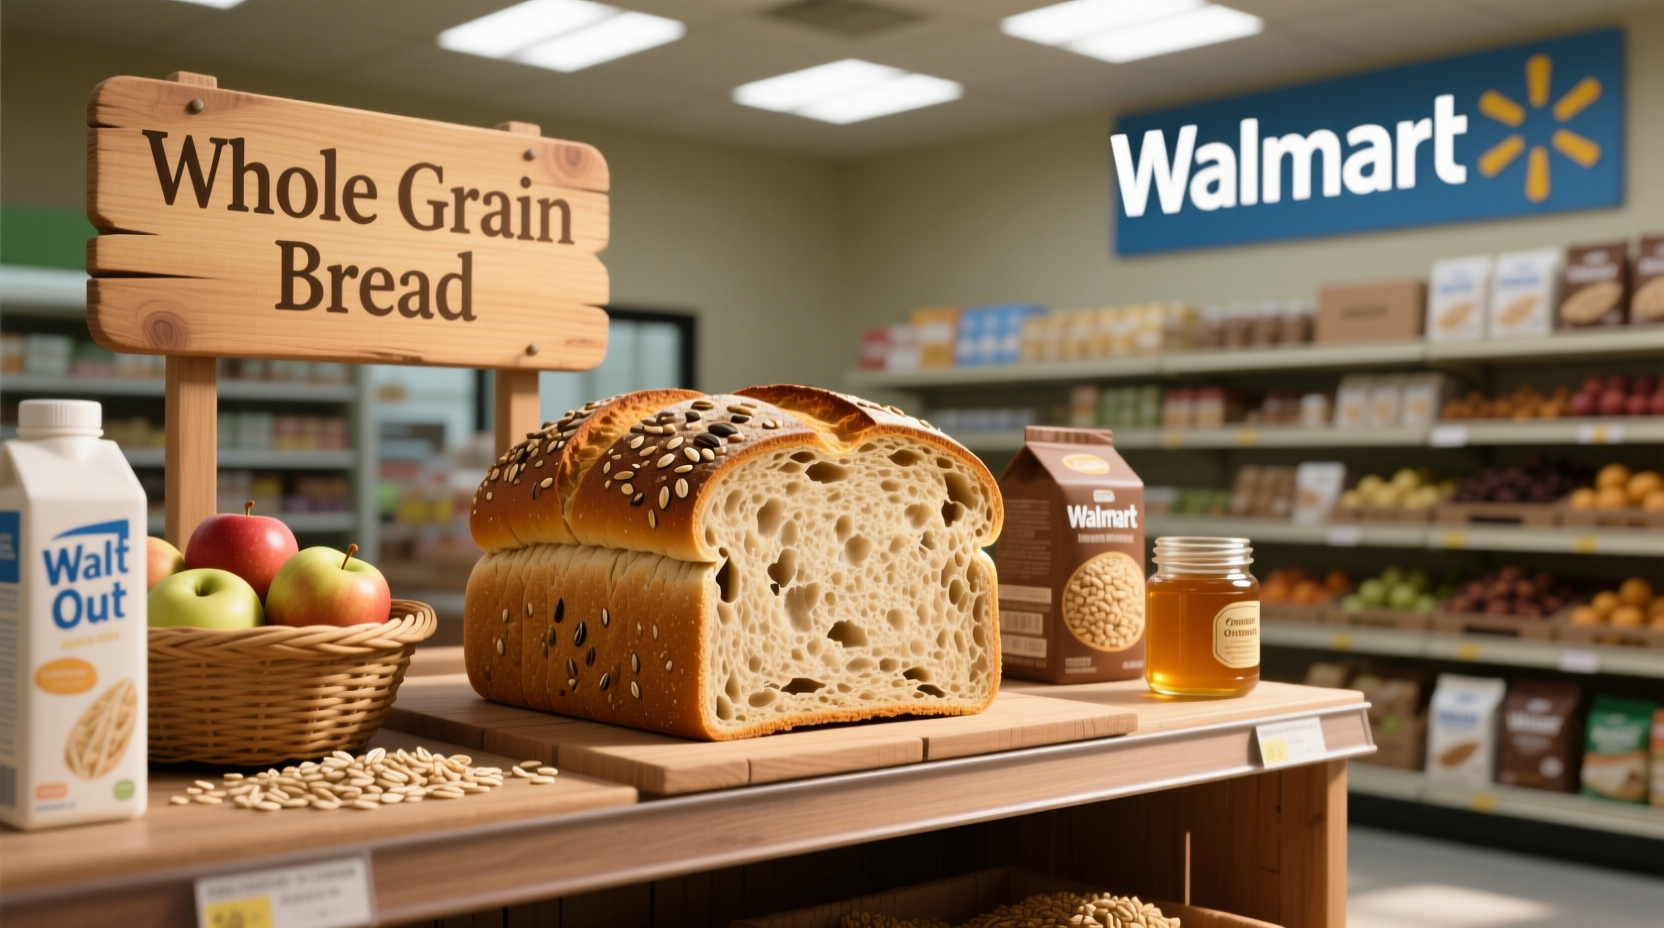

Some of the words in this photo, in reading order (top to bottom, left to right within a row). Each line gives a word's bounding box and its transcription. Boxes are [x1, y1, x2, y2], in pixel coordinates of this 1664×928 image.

[142, 129, 378, 225] Whole
[397, 162, 575, 245] Grain
[1110, 94, 1468, 218] Walmart
[274, 240, 478, 322] Bread
[1067, 504, 1138, 529] Walmart
[42, 538, 130, 586] Walt
[52, 581, 127, 630] Out
